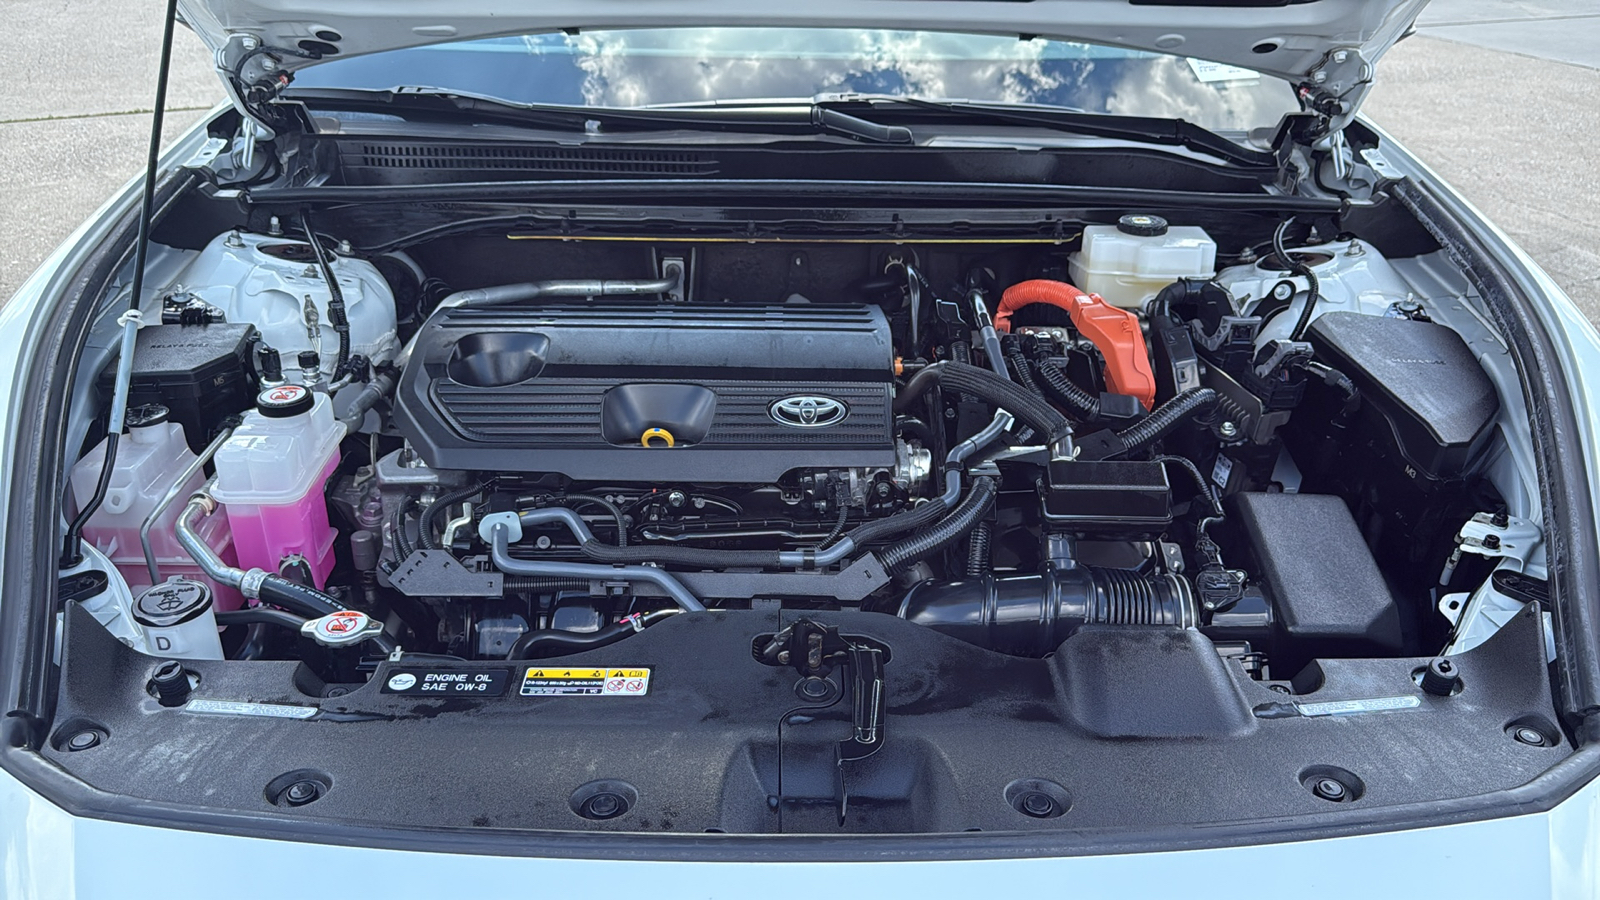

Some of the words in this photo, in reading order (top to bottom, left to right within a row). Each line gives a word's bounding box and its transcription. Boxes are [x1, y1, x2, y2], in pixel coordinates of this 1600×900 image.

[155, 636, 171, 651] D
[424, 673, 469, 682] ENGINE
[474, 674, 493, 682] OIL
[421, 682, 449, 691] SAE
[455, 682, 488, 691] 0W-8
